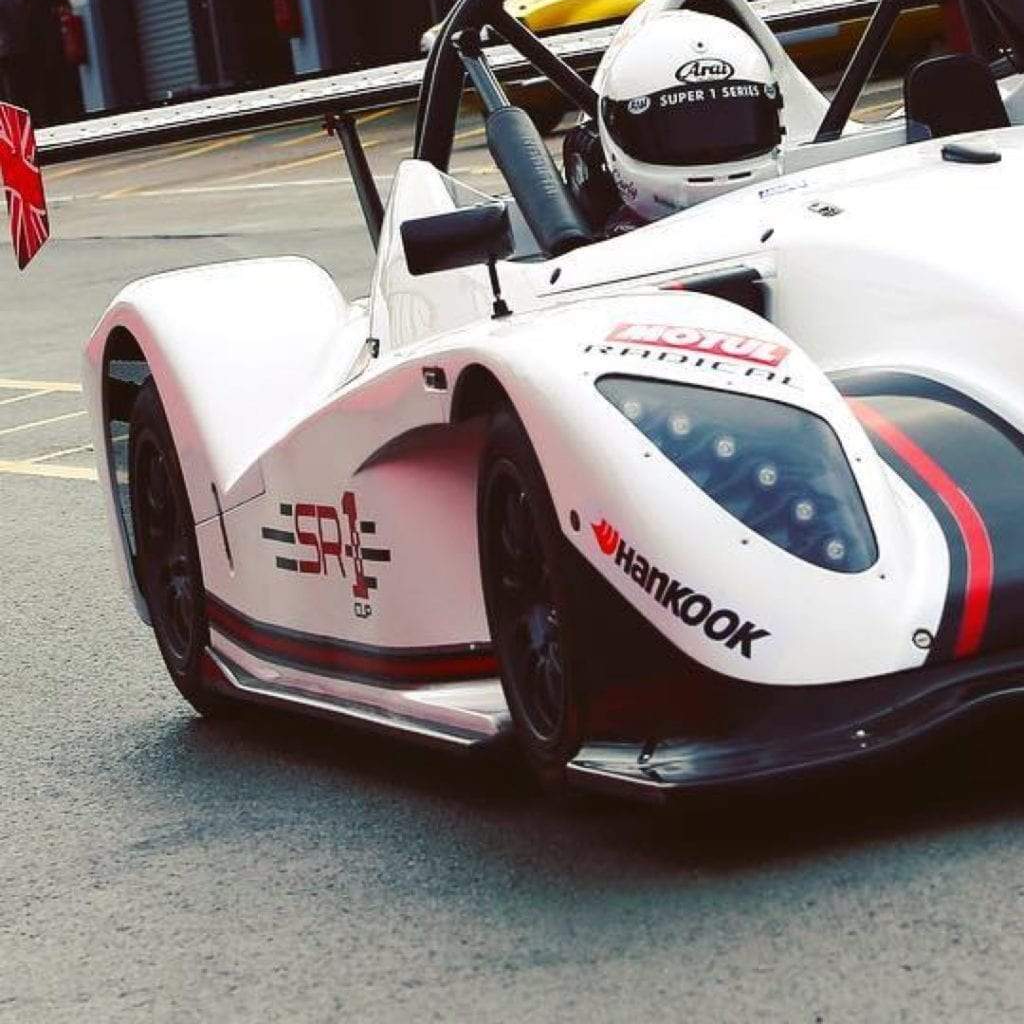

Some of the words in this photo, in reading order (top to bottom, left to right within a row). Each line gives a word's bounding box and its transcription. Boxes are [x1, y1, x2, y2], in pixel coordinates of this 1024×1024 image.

[681, 61, 729, 79] Arai
[660, 89, 705, 107] SUPER
[709, 88, 717, 99] 1
[722, 84, 760, 98] SERIES
[611, 325, 780, 364] MOTUL
[583, 344, 804, 391] RADICAL
